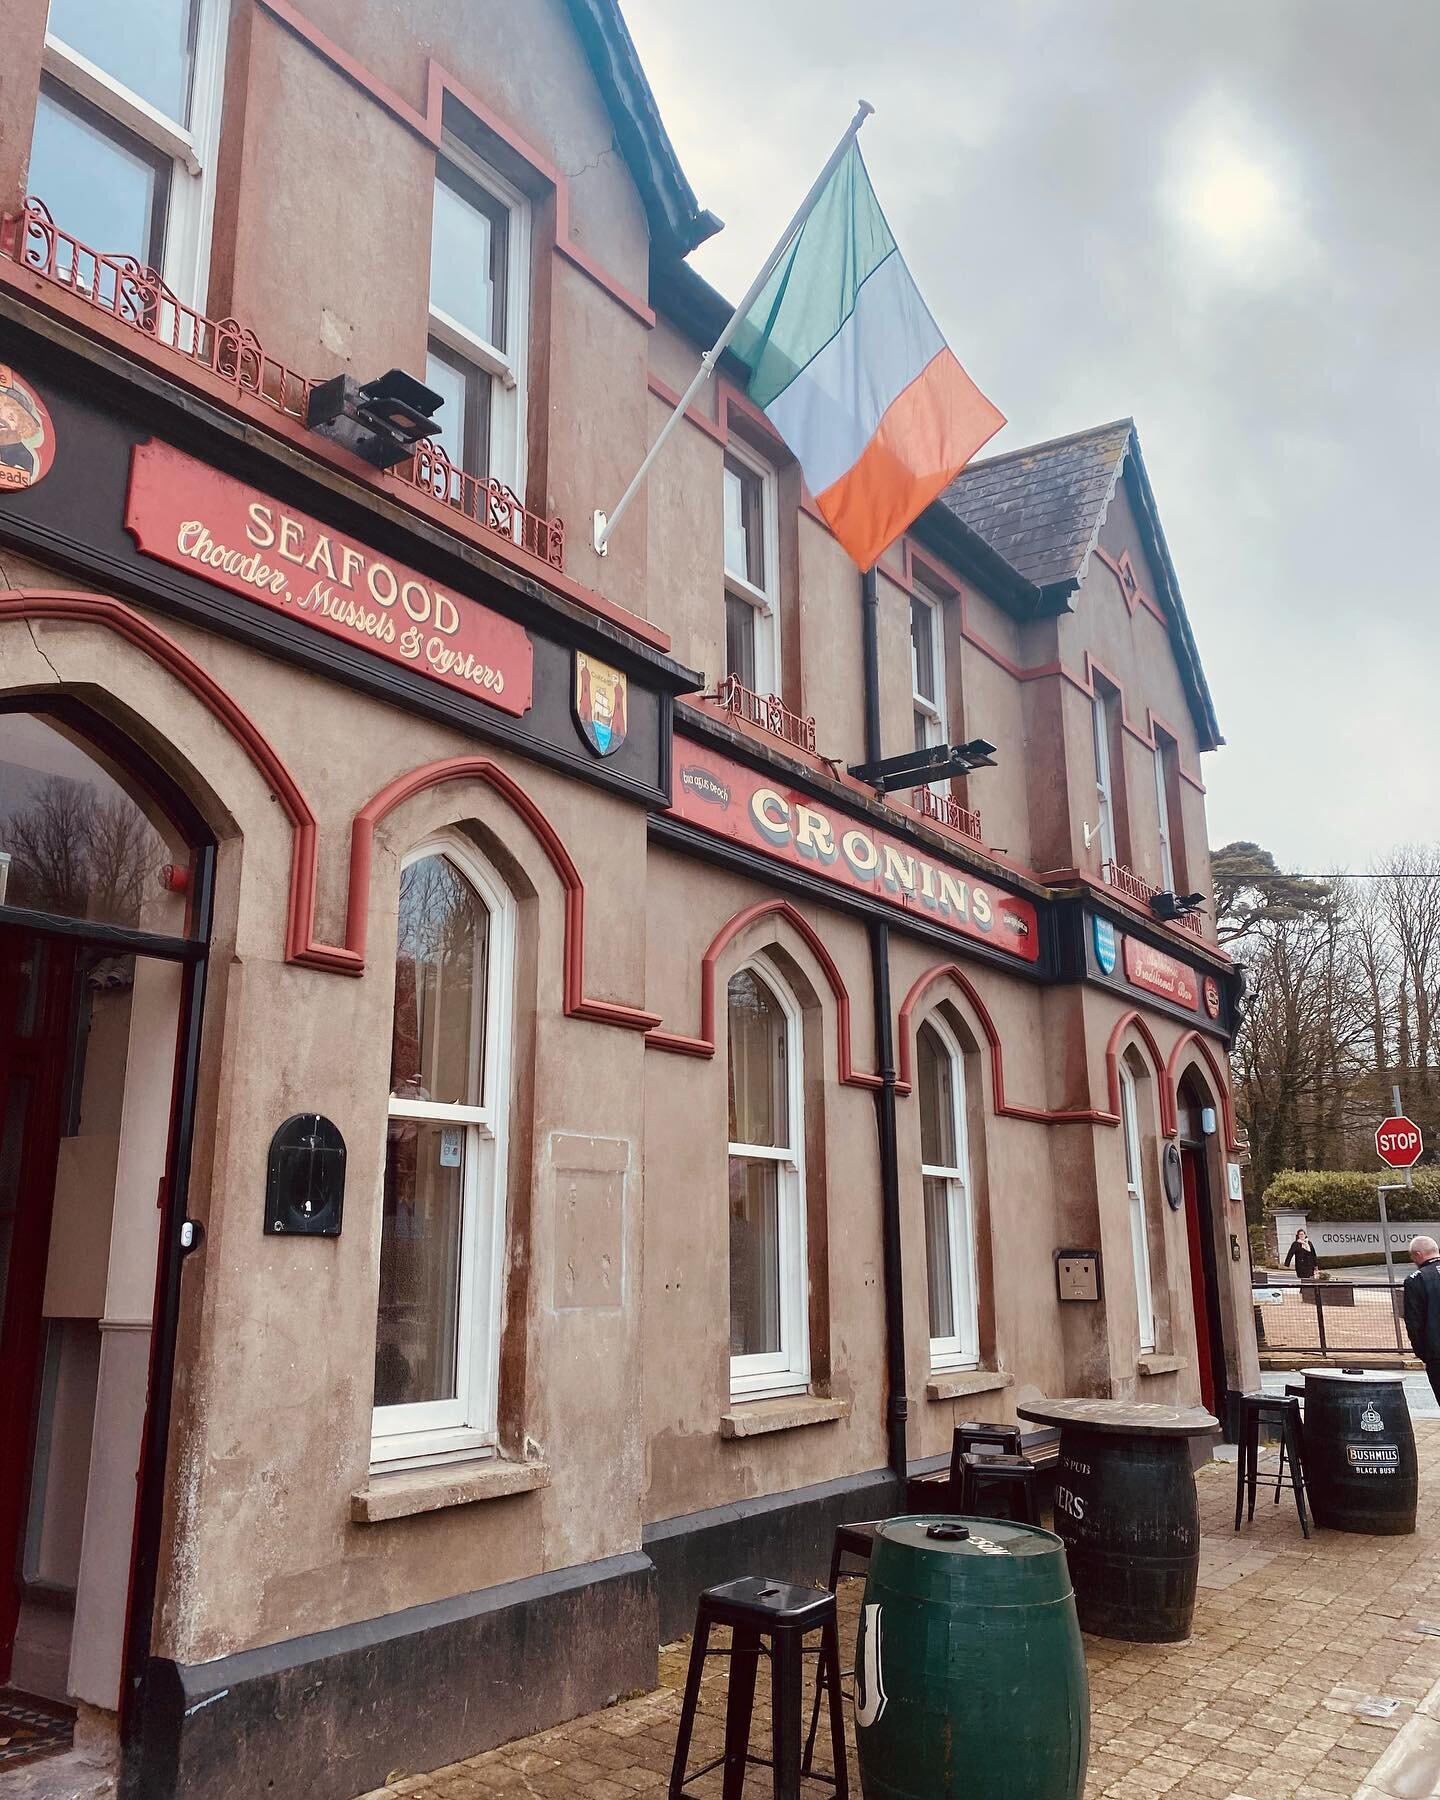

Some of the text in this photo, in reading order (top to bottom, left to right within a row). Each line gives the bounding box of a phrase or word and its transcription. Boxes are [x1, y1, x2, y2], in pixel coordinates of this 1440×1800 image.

[0, 471, 28, 486] eads
[246, 502, 460, 636] SEAFOOD
[177, 520, 505, 695] Chowder, Mussels & Oysters
[750, 787, 994, 928] CRONINS
[1380, 1132, 1418, 1152] STOP
[1322, 1232, 1418, 1244] CROSSHAVEN OUS
[1349, 1448, 1398, 1461] BUSHMILLS
[1070, 1460, 1091, 1475] PUB
[1355, 1466, 1396, 1475] BLACK BUSH
[1057, 1485, 1085, 1521] ERS
